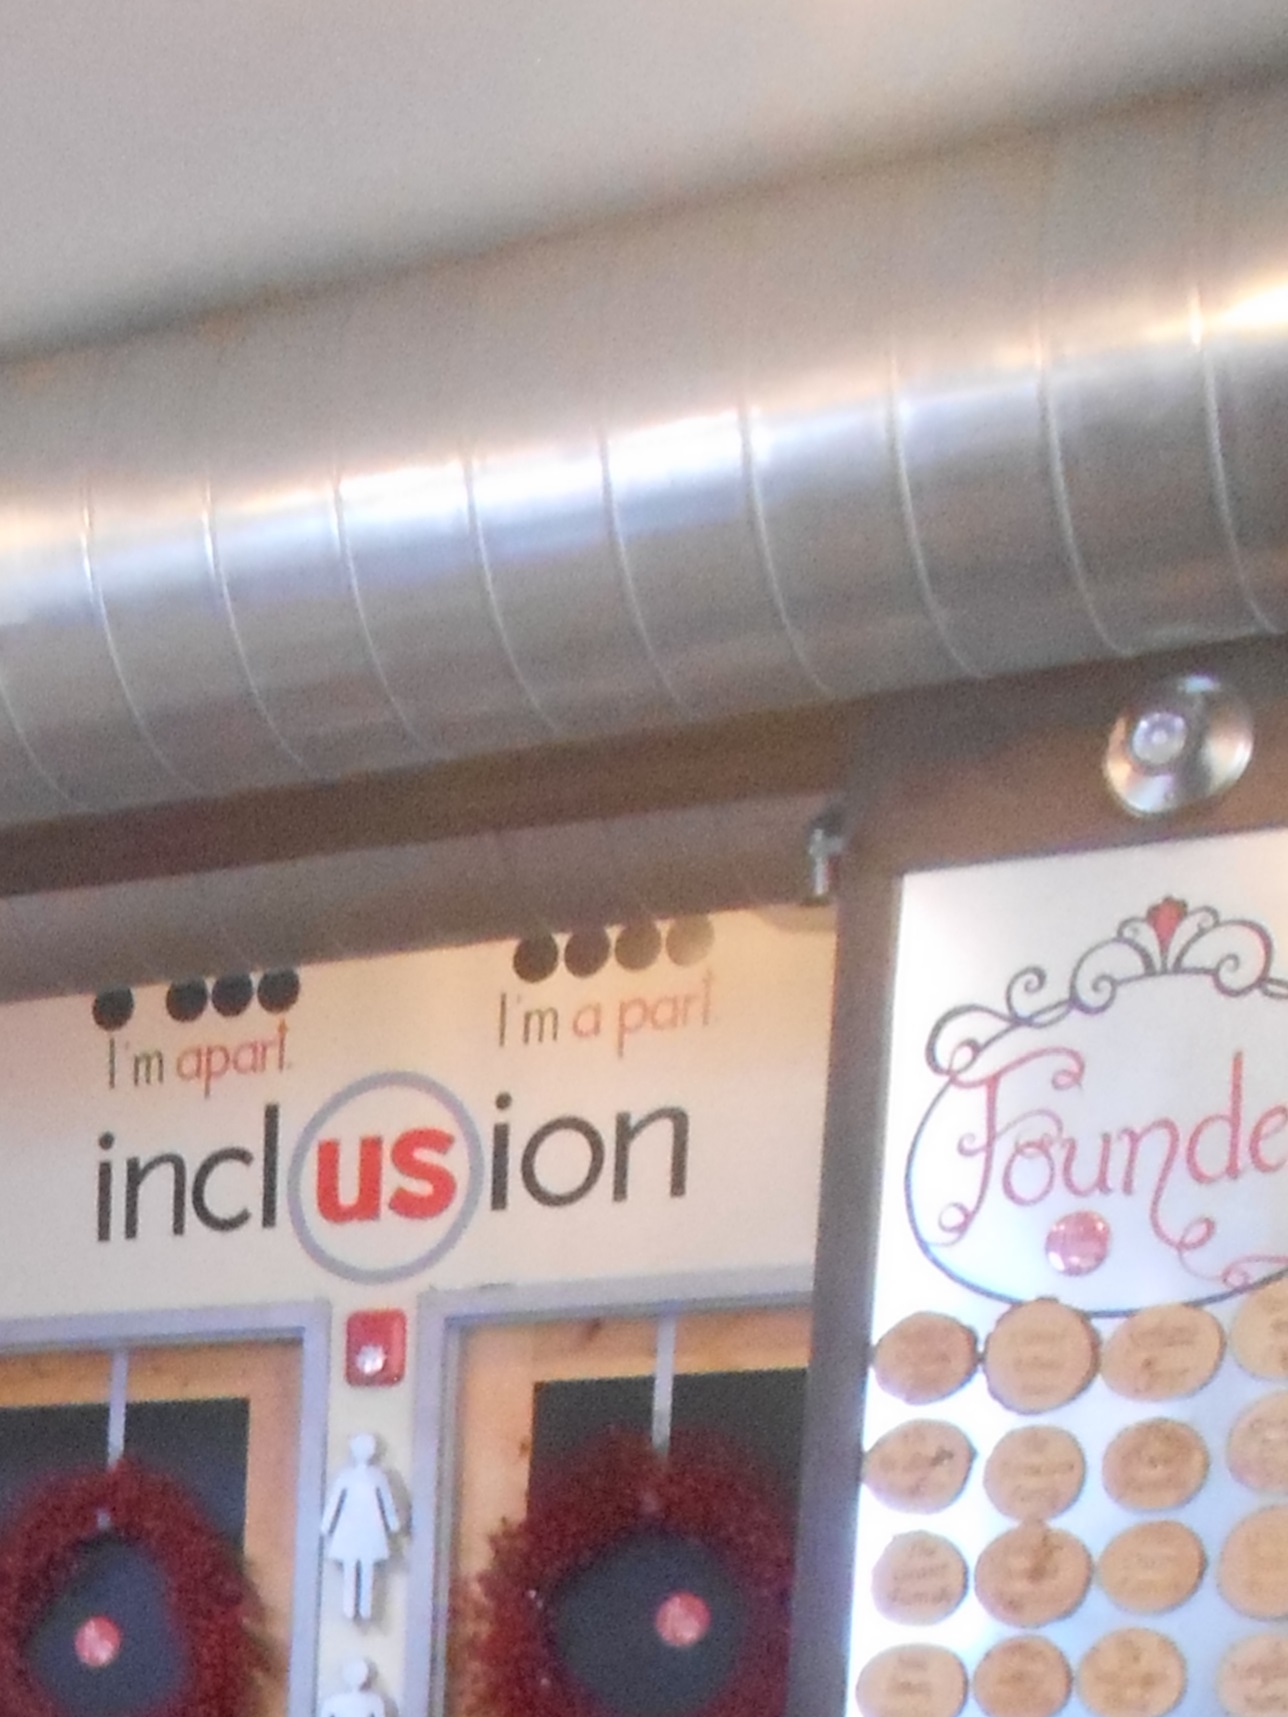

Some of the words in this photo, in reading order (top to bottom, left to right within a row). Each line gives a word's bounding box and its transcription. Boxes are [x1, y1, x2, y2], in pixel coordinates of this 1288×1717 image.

[498, 991, 559, 1048] I'm
[572, 1001, 602, 1038] a
[107, 1036, 165, 1090] I'm
